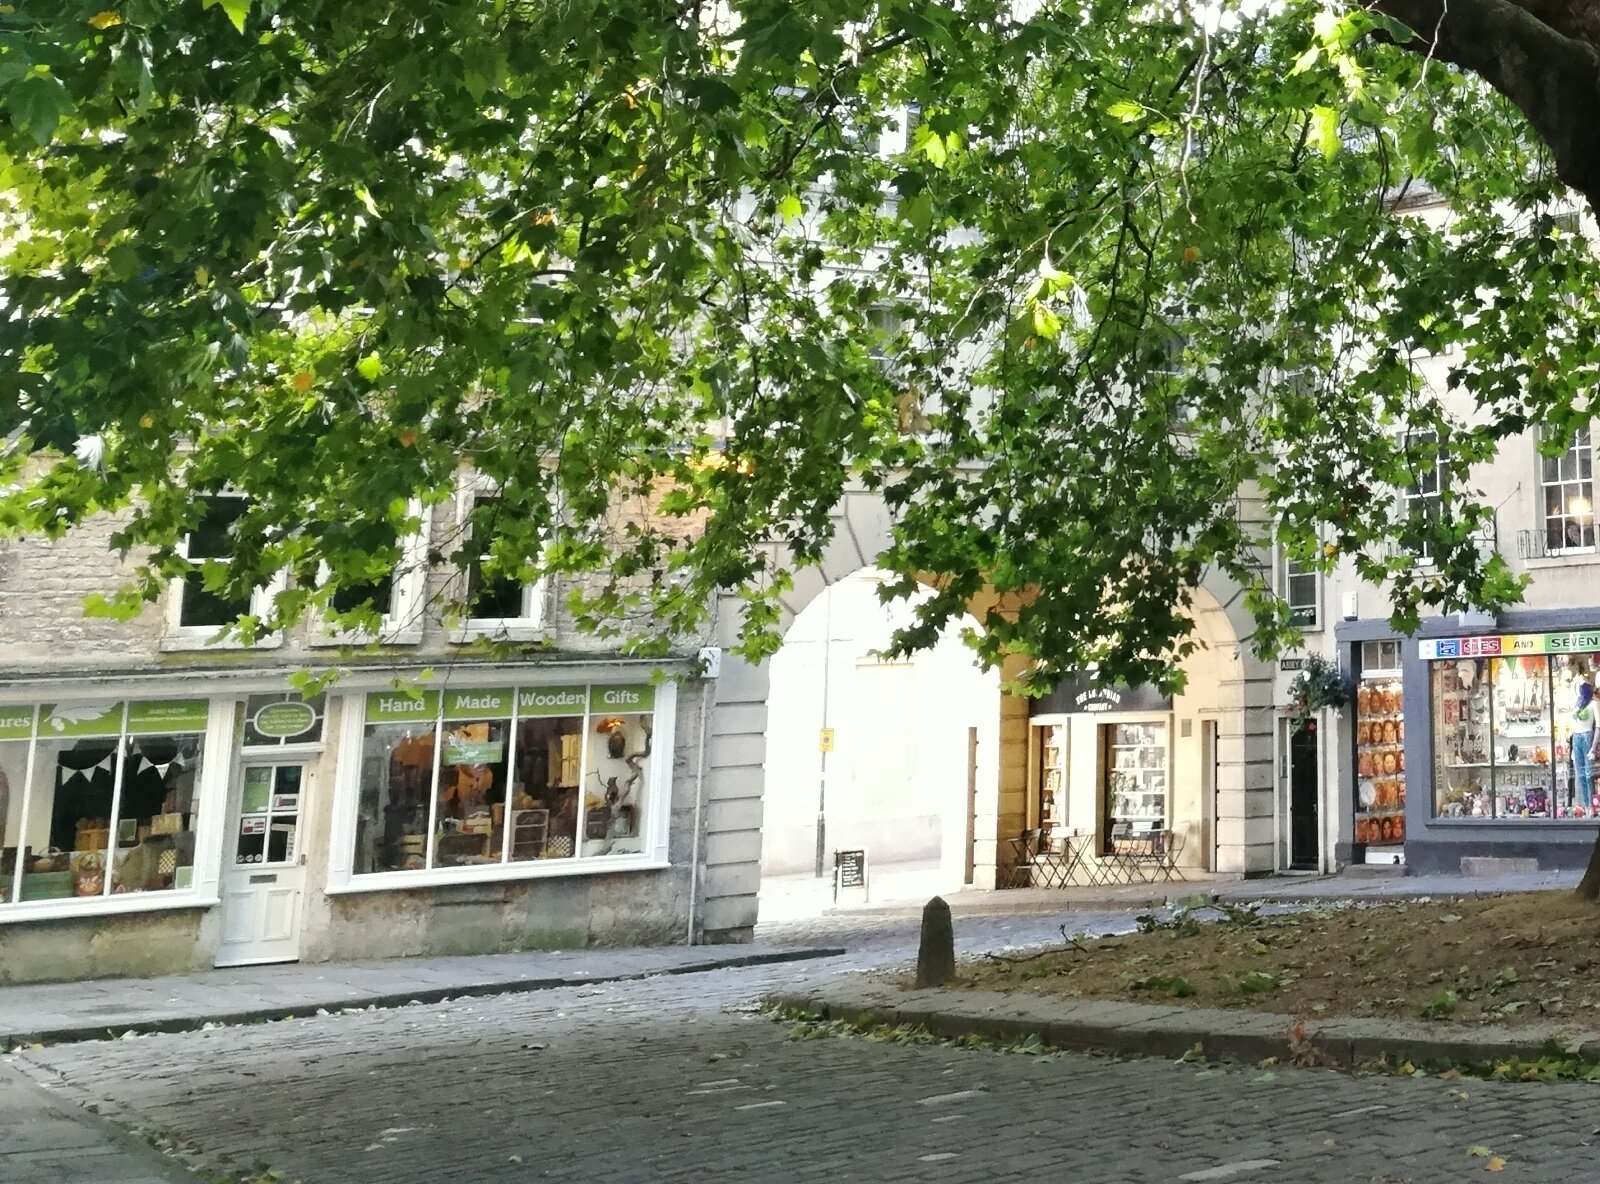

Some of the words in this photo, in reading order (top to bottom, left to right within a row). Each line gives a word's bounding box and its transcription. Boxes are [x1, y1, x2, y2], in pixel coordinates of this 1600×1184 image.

[1513, 640, 1534, 649] AND
[379, 698, 425, 712] Hand
[455, 695, 501, 709] Made
[519, 691, 586, 706] Wooden
[603, 690, 639, 704] Gifts
